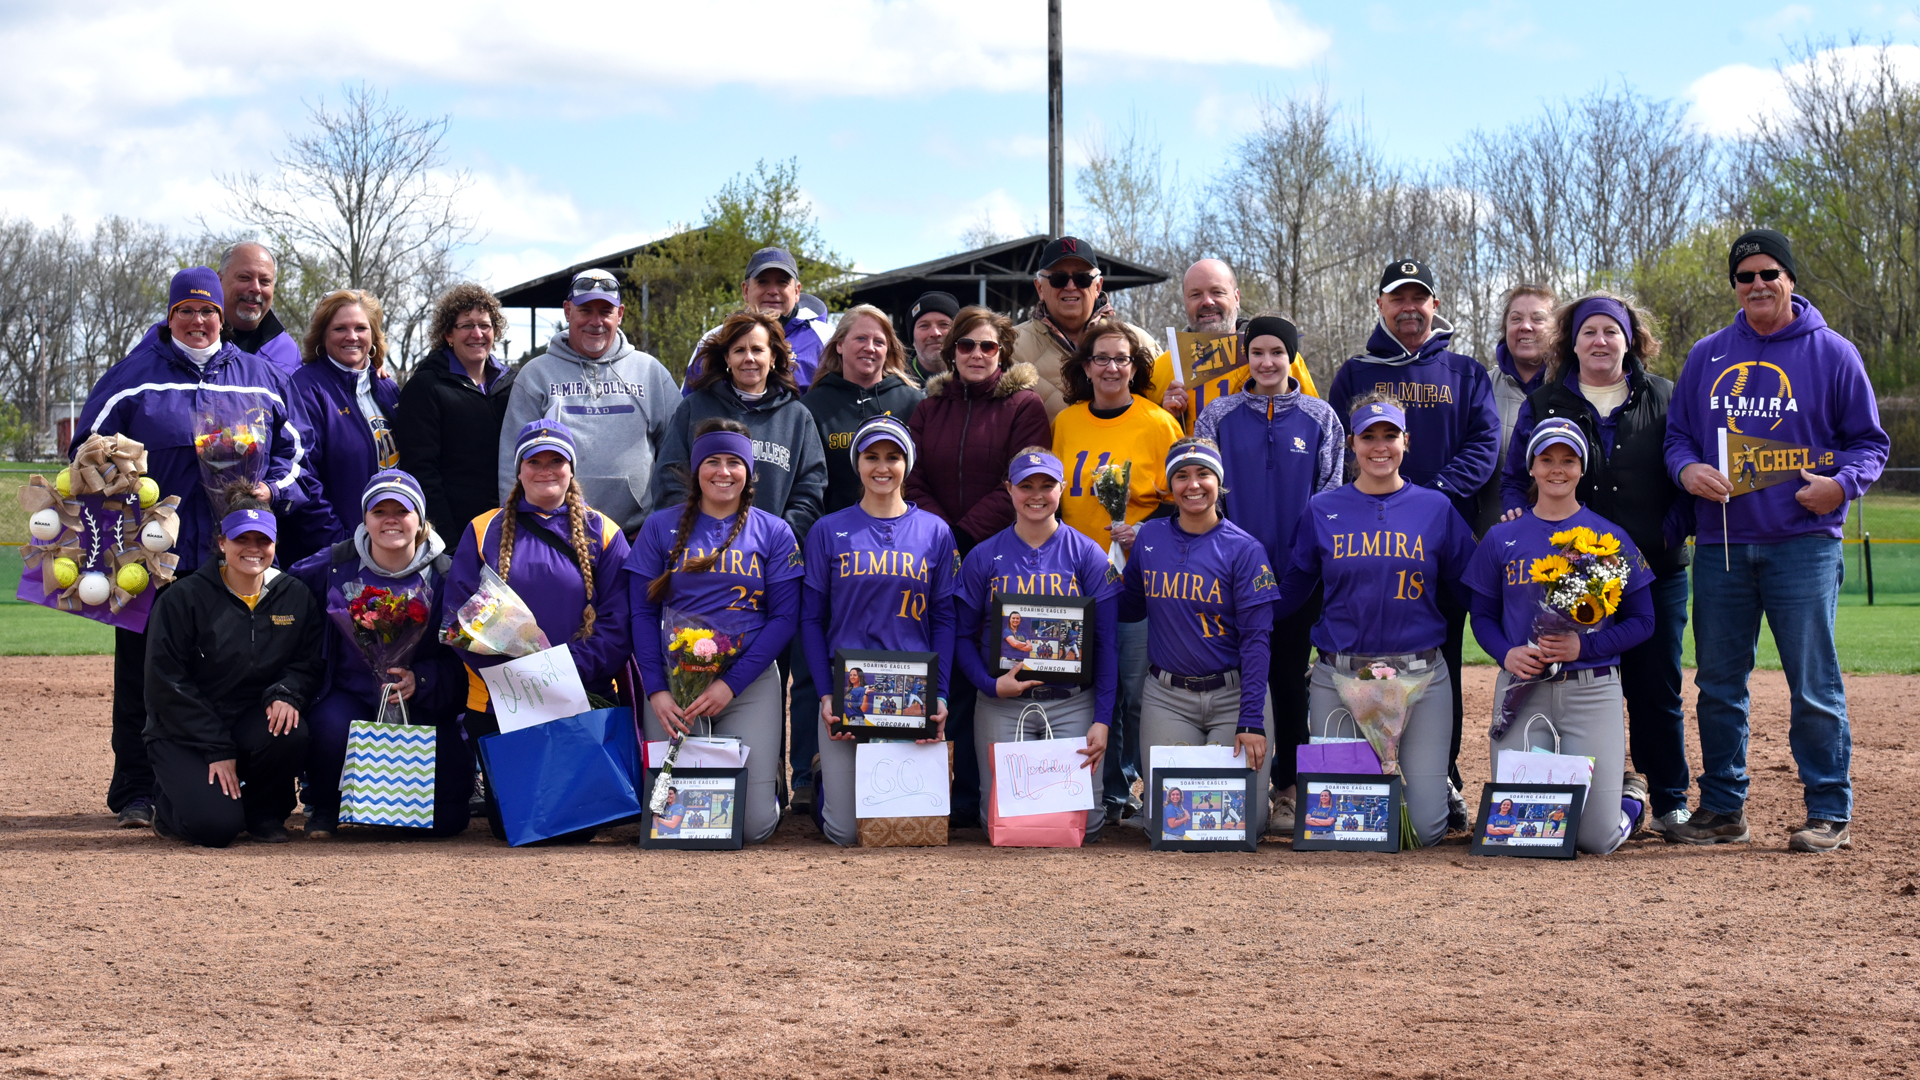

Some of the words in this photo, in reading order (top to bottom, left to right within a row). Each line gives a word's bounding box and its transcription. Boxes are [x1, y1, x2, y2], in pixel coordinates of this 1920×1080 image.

[1061, 238, 1077, 253] N
[1404, 264, 1414, 272] B
[550, 382, 590, 397] ELMIRA
[598, 381, 645, 398] COLLEGE
[1375, 381, 1453, 404] ELMIRA
[1710, 396, 1798, 412] ELMIRA
[1727, 409, 1780, 418] SOFTBALL
[751, 440, 790, 472] OLLEGE
[1818, 451, 1834, 466] #2
[1333, 530, 1425, 562] ELMIRA
[839, 550, 928, 583] ELMIRA
[1143, 569, 1224, 605] ELMIRA
[1393, 569, 1424, 600] 18
[726, 585, 764, 611] 25
[896, 589, 927, 622] 10
[1195, 612, 1229, 638] 11
